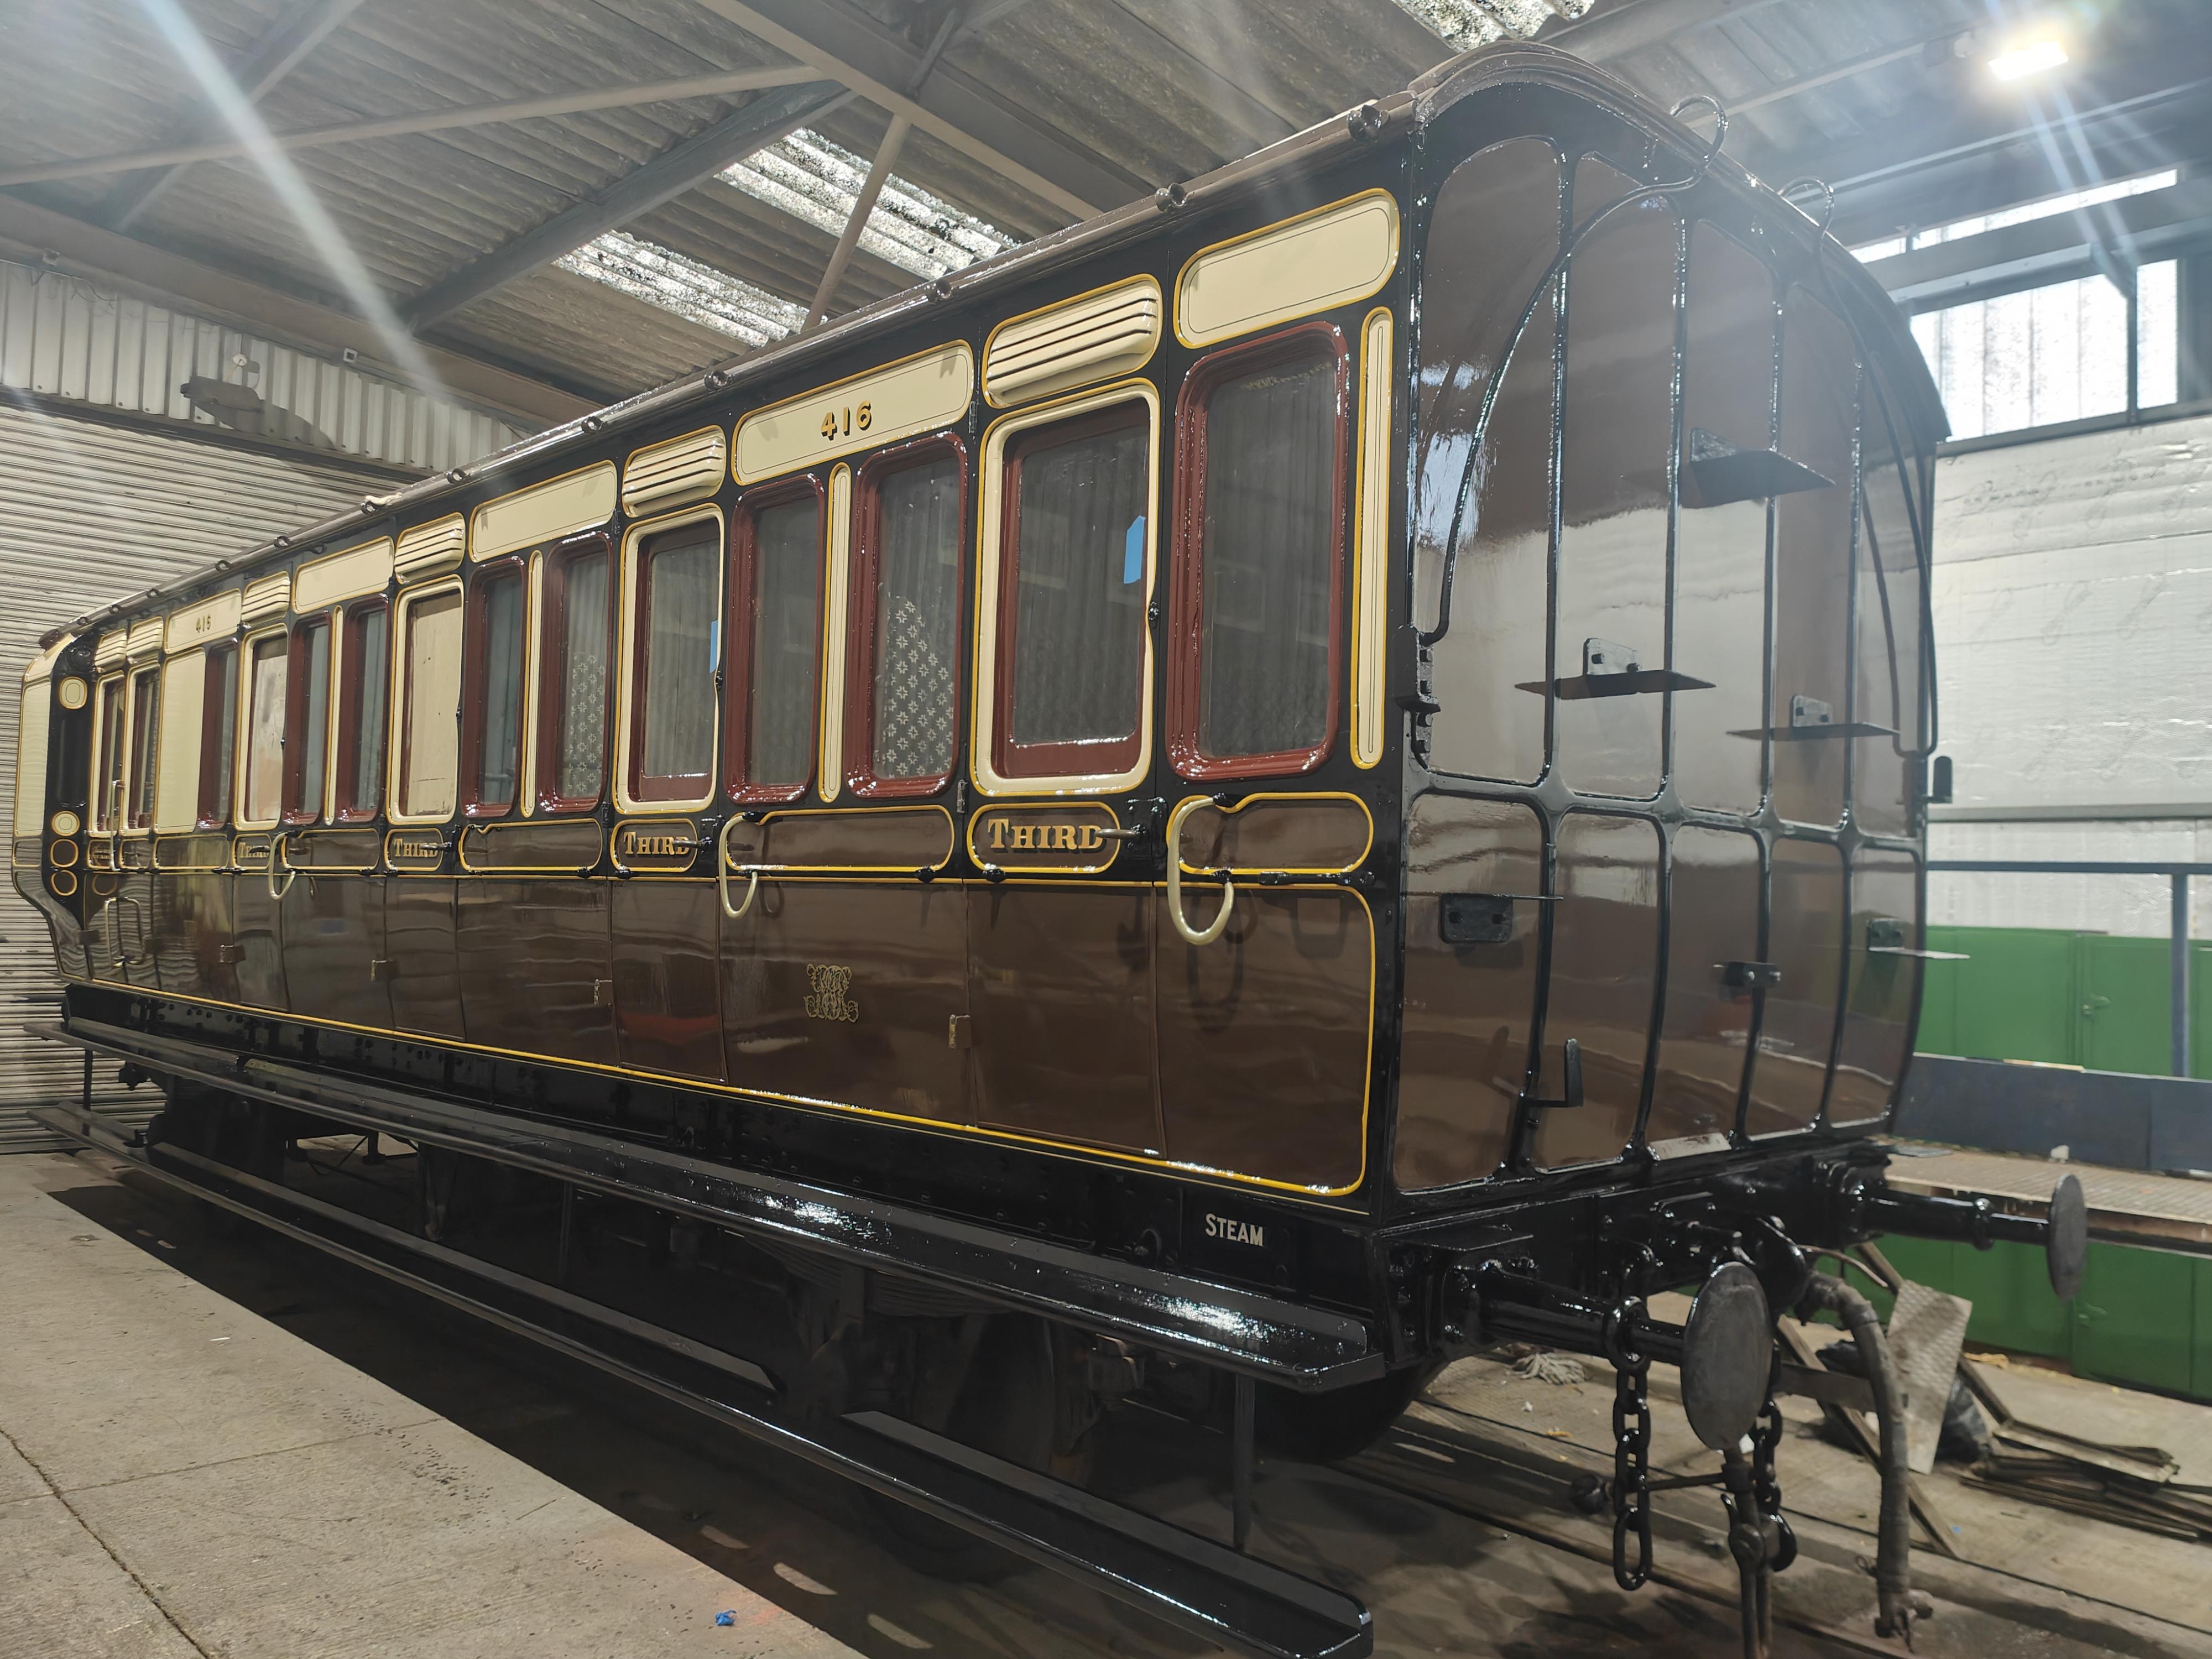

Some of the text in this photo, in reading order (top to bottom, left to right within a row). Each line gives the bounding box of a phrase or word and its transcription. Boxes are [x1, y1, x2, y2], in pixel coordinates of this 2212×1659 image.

[821, 400, 872, 441] 416
[623, 831, 690, 855] THIRD
[988, 818, 1104, 852] THIRD
[1205, 1213, 1264, 1247] STEAM
